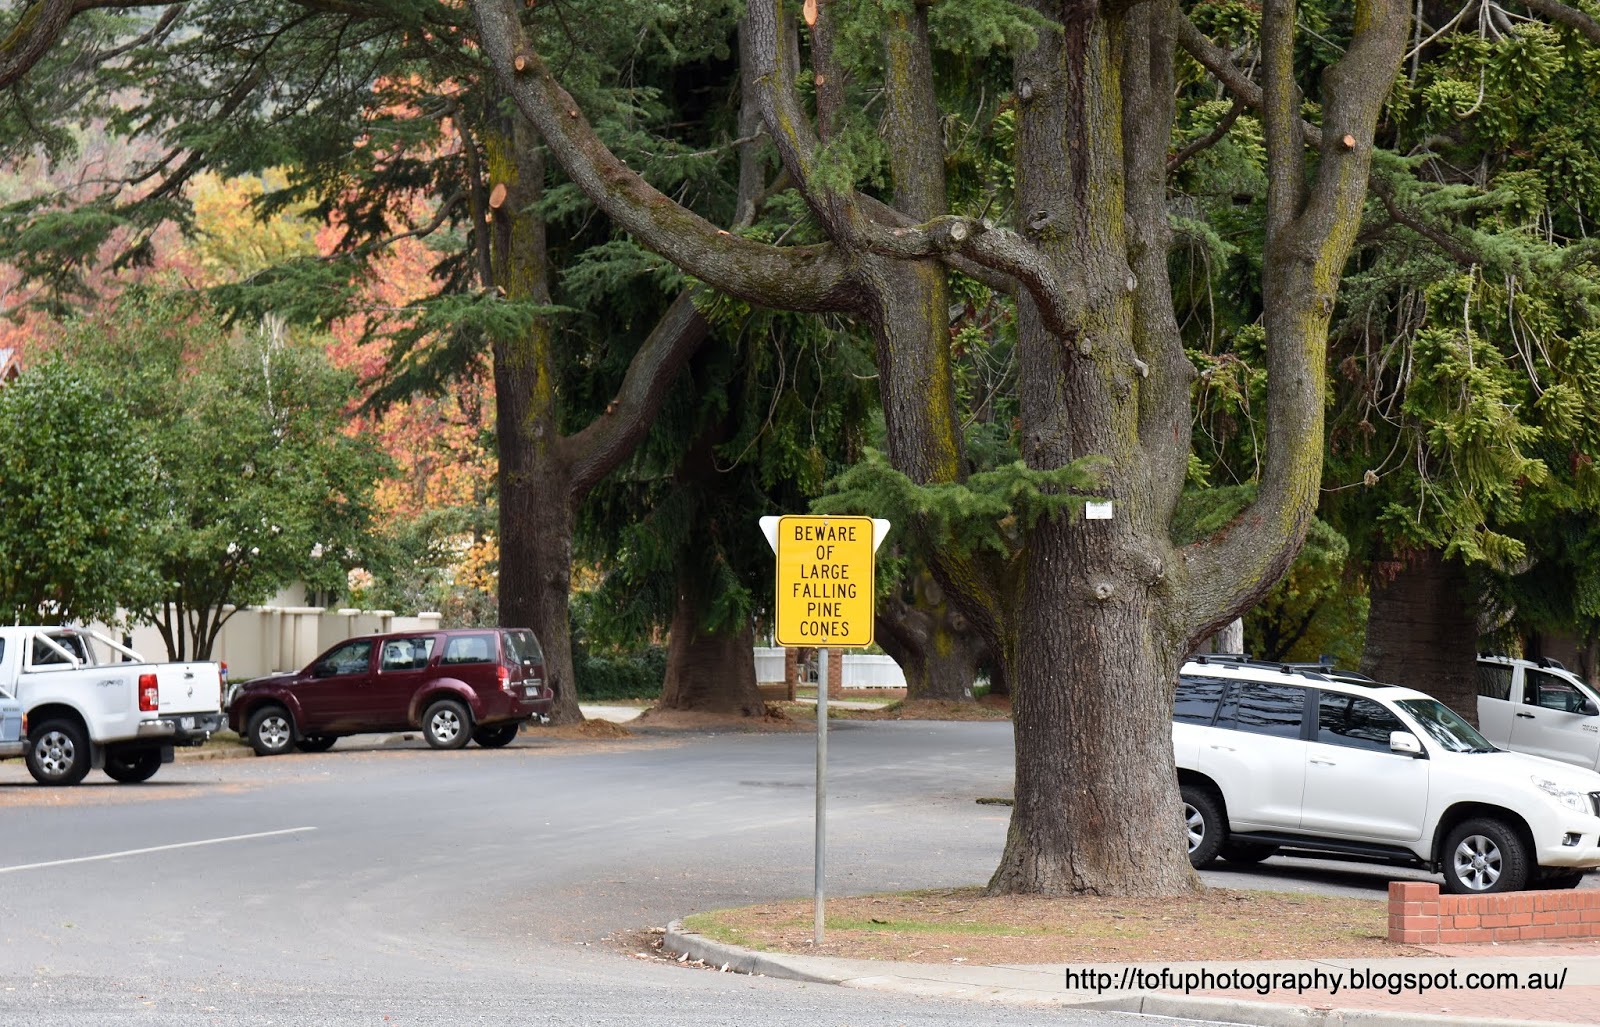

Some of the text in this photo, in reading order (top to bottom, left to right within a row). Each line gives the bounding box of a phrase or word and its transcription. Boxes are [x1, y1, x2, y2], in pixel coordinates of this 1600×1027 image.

[795, 526, 857, 542] BEWARE
[816, 545, 835, 560] OF
[801, 564, 849, 579] LARGE
[793, 583, 857, 598] FALLING
[807, 602, 842, 617] PINE
[800, 621, 849, 636] CONES
